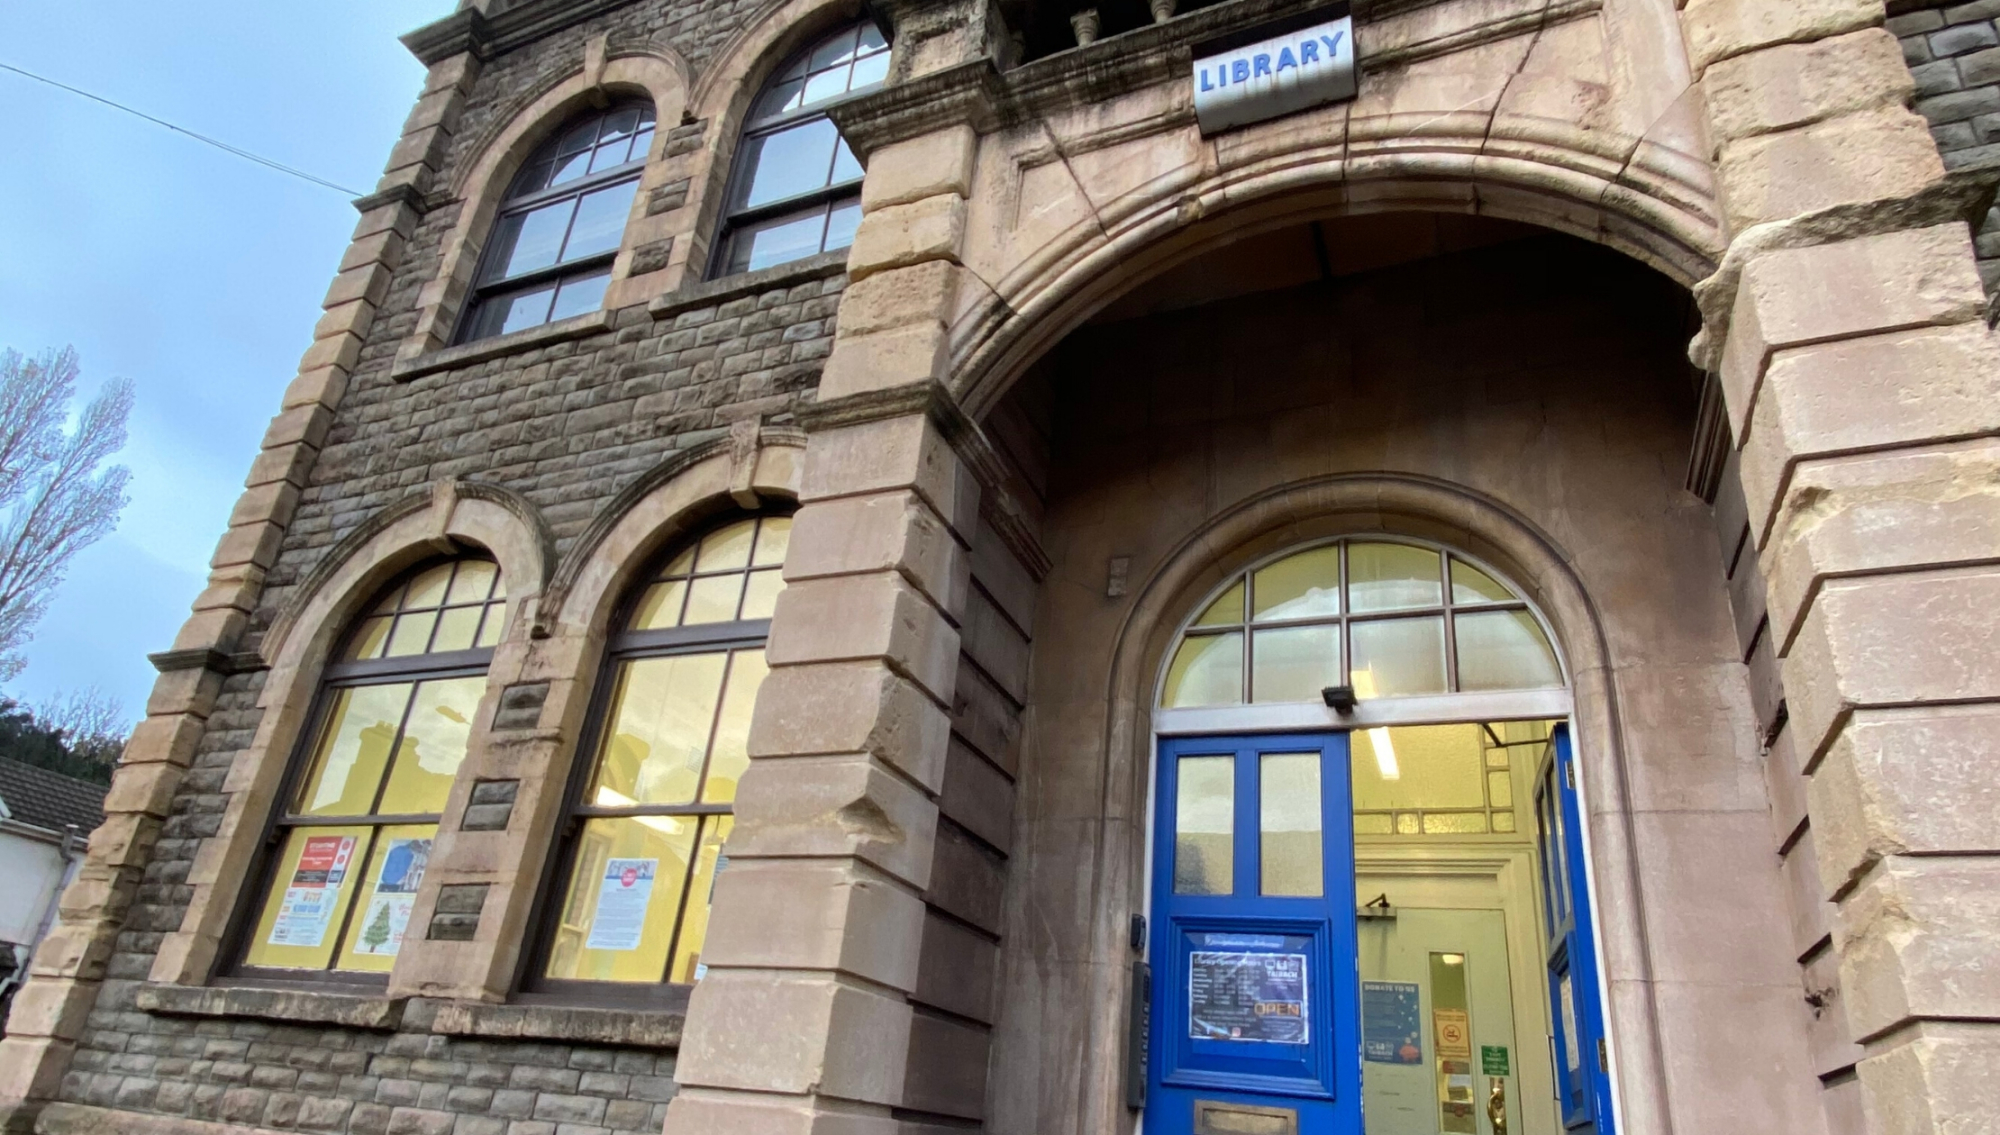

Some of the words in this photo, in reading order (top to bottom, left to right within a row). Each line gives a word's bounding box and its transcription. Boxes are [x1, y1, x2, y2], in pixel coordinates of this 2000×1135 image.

[1200, 30, 1344, 92] LIBRARY
[1267, 970, 1298, 978] TAIBACH
[1364, 984, 1394, 992] DONATE
[1254, 1003, 1300, 1015] OPEN
